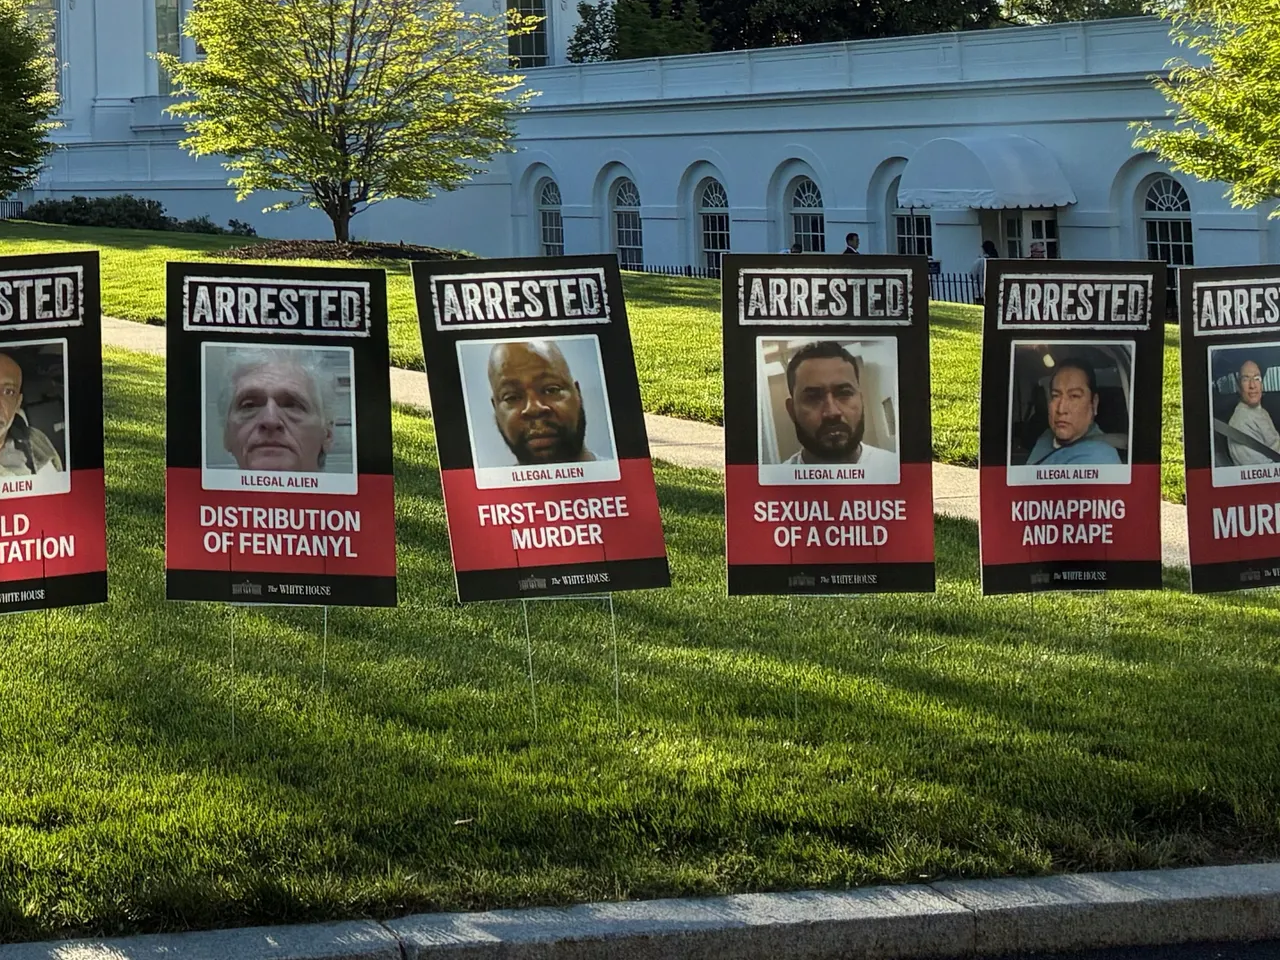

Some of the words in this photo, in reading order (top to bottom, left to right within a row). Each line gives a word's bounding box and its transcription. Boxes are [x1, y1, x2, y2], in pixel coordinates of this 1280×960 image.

[192, 285, 362, 328] ARRESTED
[443, 277, 602, 322] ARRESTED
[748, 277, 905, 317] ARRESTED
[1005, 283, 1145, 322] ARRESTED
[1200, 287, 1280, 328] ARRES
[240, 475, 285, 487] ILLEGAL
[287, 476, 319, 489] ALIEN
[512, 469, 553, 482] ILLEGAL
[555, 467, 584, 480] ALIEN
[794, 469, 834, 480] ILLEGAL
[836, 469, 865, 480] ALIEN
[1036, 469, 1071, 480] ILLEGAL
[1072, 469, 1099, 480] ALIEN
[1240, 468, 1272, 480] ILLEGAL
[2, 480, 33, 494] ALIEN
[200, 505, 361, 532] DISTRIBUTION
[477, 496, 630, 527] FIRST-DEGREE
[753, 500, 834, 522] SEXUAL
[839, 499, 907, 520] ABUSE
[1011, 499, 1126, 522] KIDNAPPING
[203, 531, 234, 554] OF
[239, 532, 358, 558] FENTANYL
[511, 524, 604, 550] MURDER
[774, 526, 802, 548] OF
[806, 526, 822, 547] A
[825, 525, 888, 547] CHILD
[1022, 525, 1058, 546] AND
[1062, 524, 1113, 545] RAPE
[551, 577, 562, 586] The
[561, 574, 585, 586] WHITE
[586, 573, 611, 583] HOUSE
[820, 576, 830, 584] The
[830, 574, 854, 585] WHITE
[854, 574, 878, 585] HOUSE
[1053, 572, 1061, 580] The
[1061, 570, 1083, 581] WHITE
[1083, 570, 1107, 581] HOUSE
[21, 589, 46, 601] HOUSE
[268, 585, 278, 593] The
[279, 584, 305, 596] WHITE
[305, 585, 332, 596] HOUSE
